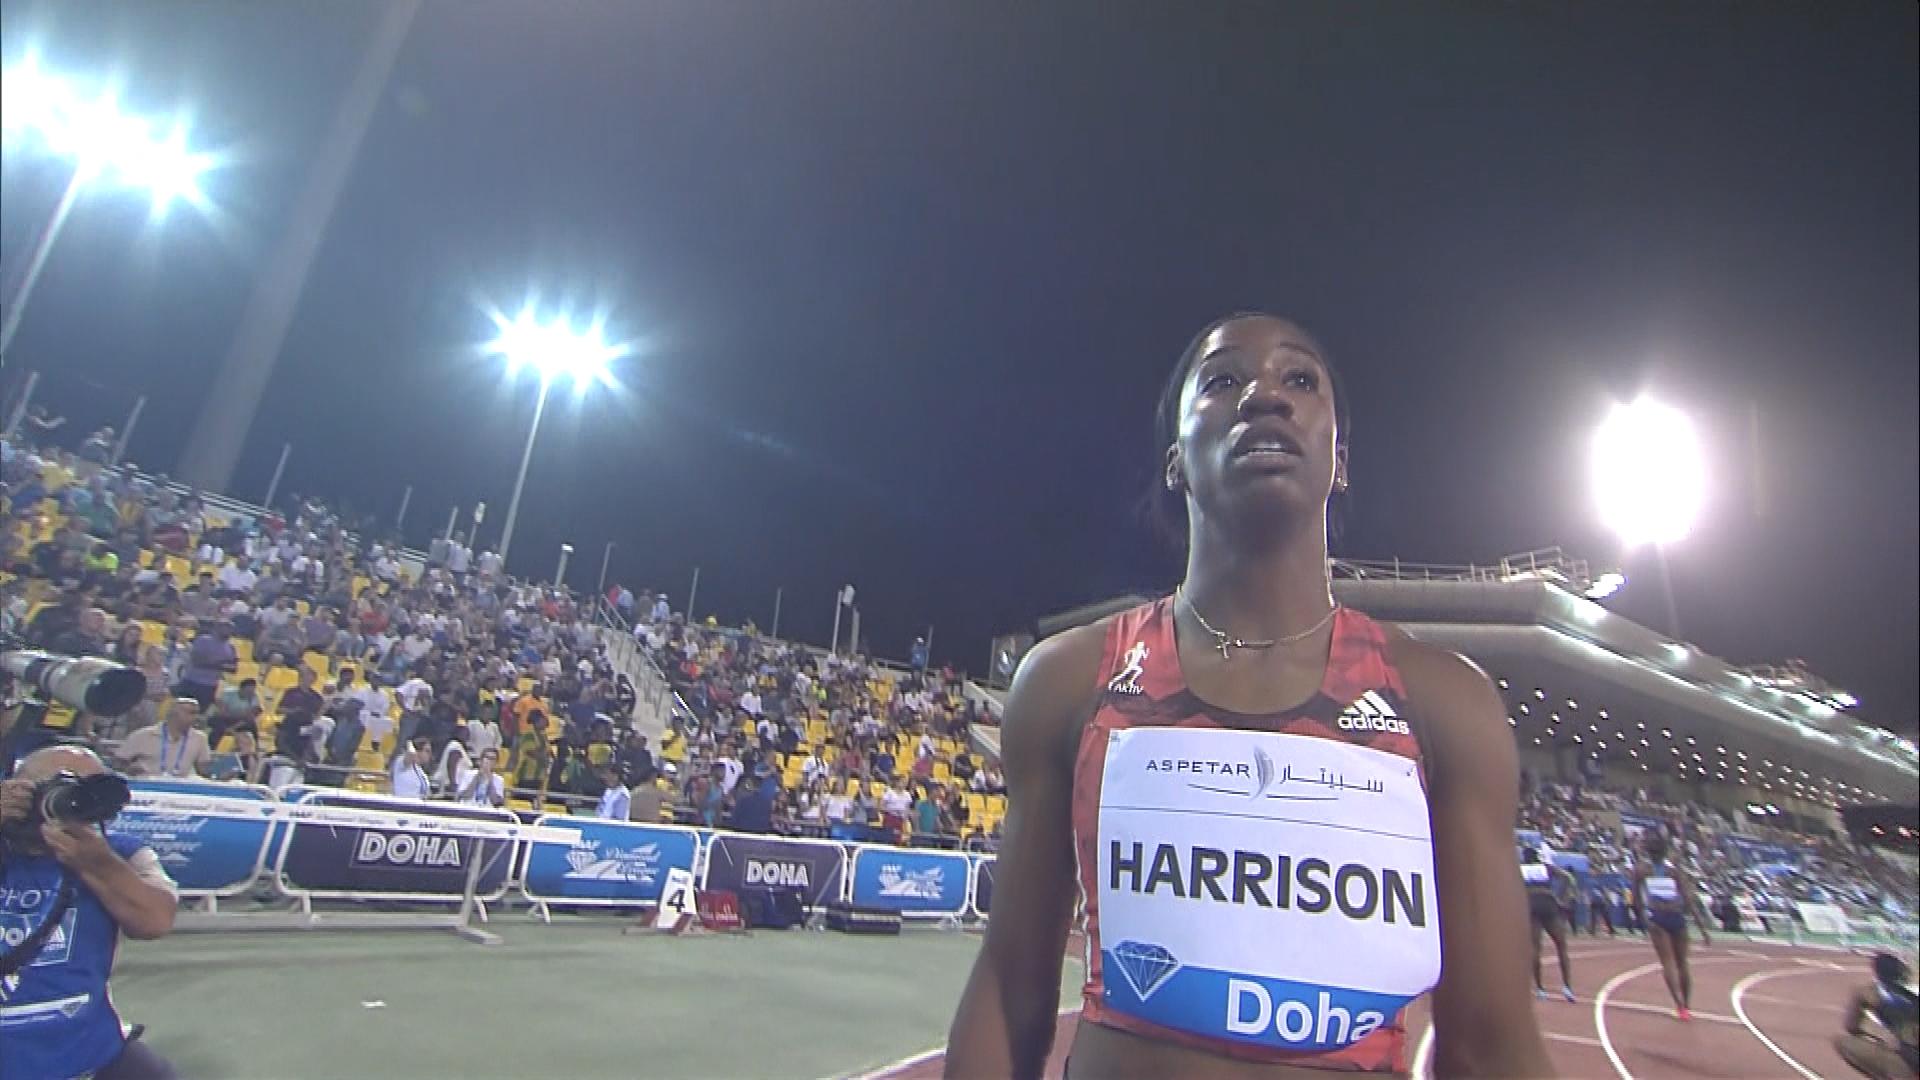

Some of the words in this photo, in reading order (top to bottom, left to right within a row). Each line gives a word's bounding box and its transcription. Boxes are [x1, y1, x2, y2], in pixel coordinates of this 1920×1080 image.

[1337, 712, 1410, 735] adidas
[1145, 759, 1251, 779] ASPETAR
[357, 831, 462, 867] DOHA
[746, 861, 810, 887] DOHA
[1109, 840, 1427, 928] HARRISON
[667, 888, 686, 913] 4
